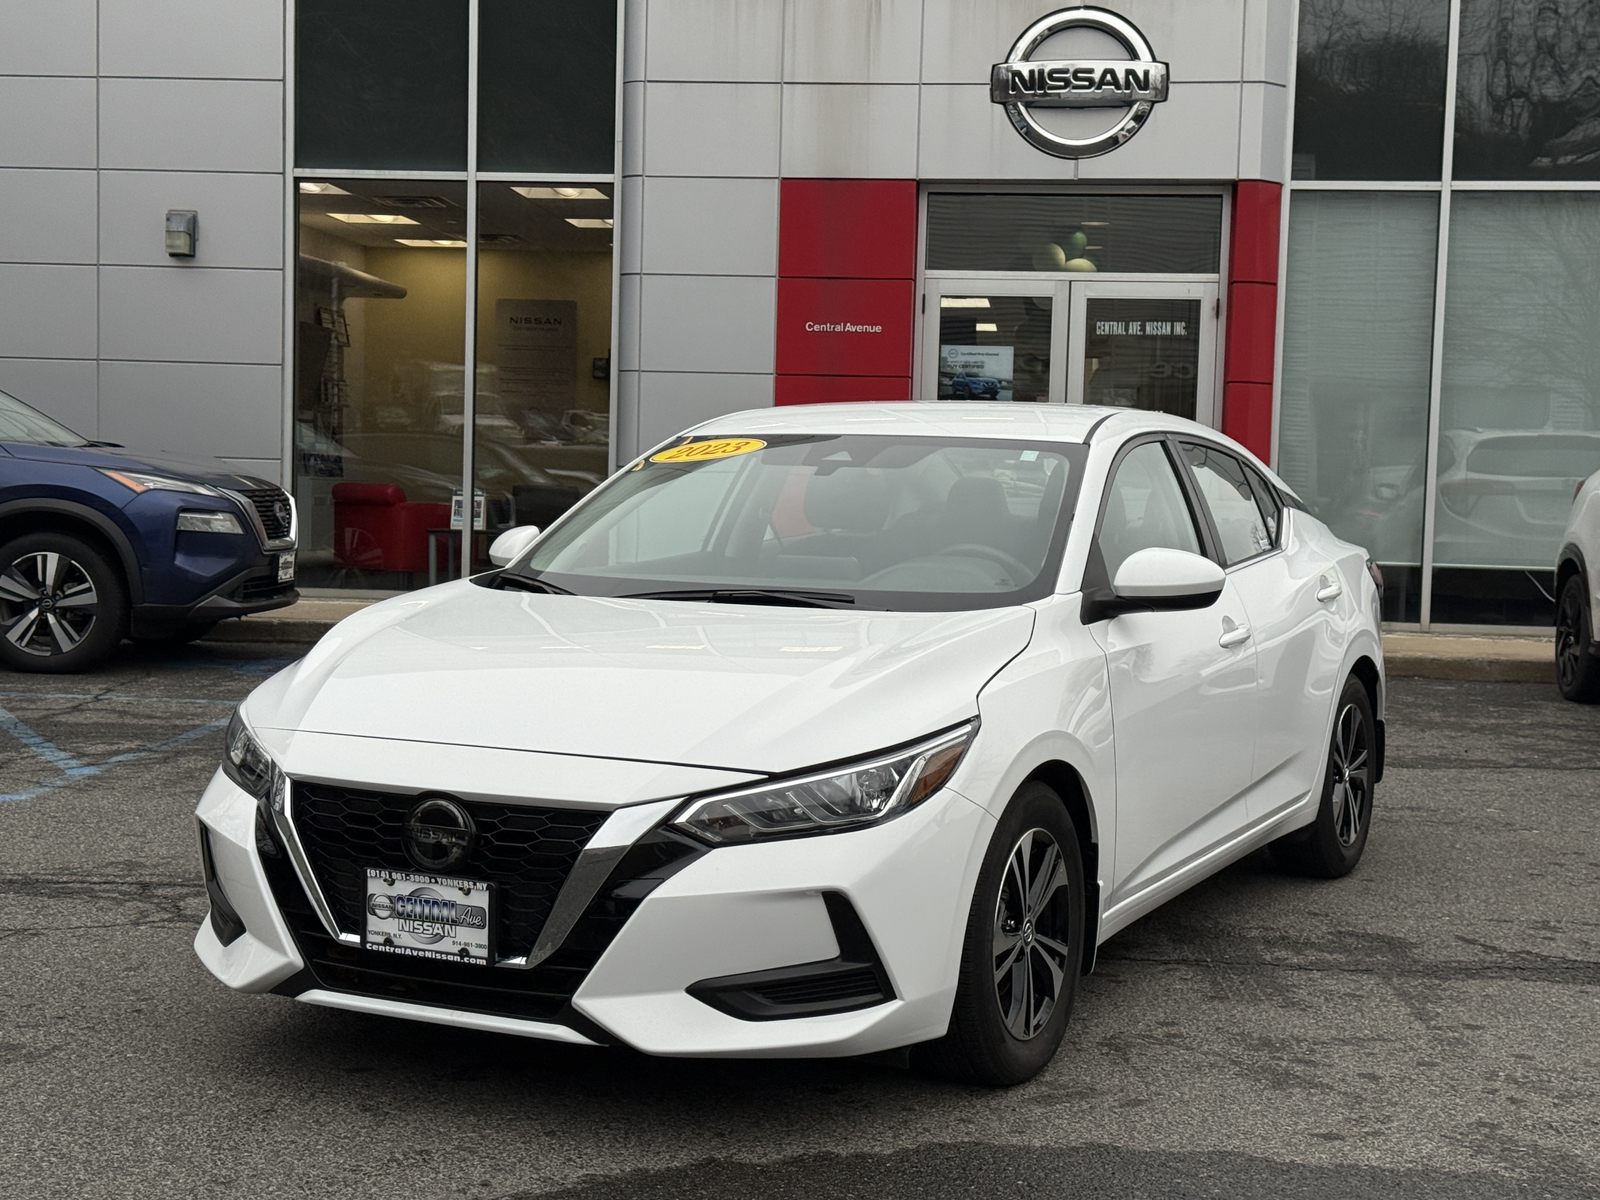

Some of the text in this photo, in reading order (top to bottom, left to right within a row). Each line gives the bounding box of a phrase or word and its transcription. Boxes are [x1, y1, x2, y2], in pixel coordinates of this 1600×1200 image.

[1009, 67, 1150, 94] NISSAN
[509, 316, 563, 325] NISSAN
[805, 321, 883, 333] Central Avenue
[1096, 321, 1188, 335] CENTRAL AVE. NISSAN INC.
[666, 441, 751, 460] 2023
[371, 902, 394, 911] NISSAN
[395, 894, 484, 927] CENTRAL Ave.
[397, 919, 457, 938] NISSAN
[366, 943, 487, 965] CentralAveNissan.com
